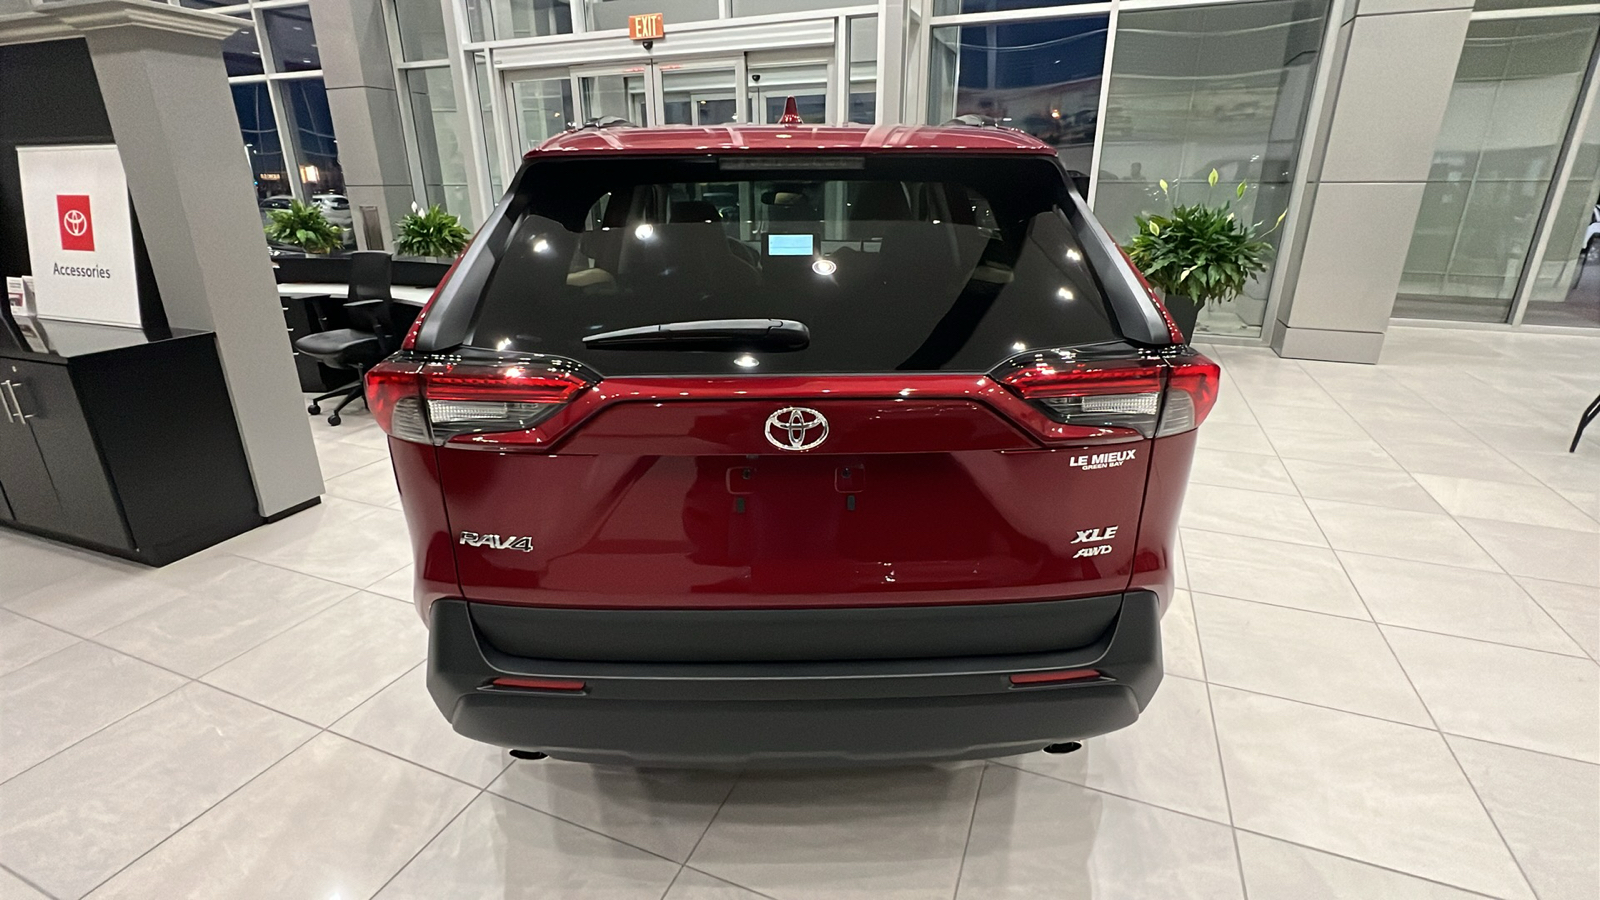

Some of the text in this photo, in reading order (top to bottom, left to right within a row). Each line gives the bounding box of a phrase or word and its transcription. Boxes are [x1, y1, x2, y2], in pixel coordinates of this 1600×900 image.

[635, 16, 656, 37] EXIT
[53, 262, 111, 278] Accessories
[1069, 449, 1136, 466] LE MIEUX
[1109, 460, 1123, 468] BAY
[459, 531, 533, 552] RAV4
[1070, 525, 1119, 544] XLE
[1072, 544, 1112, 559] AWD
